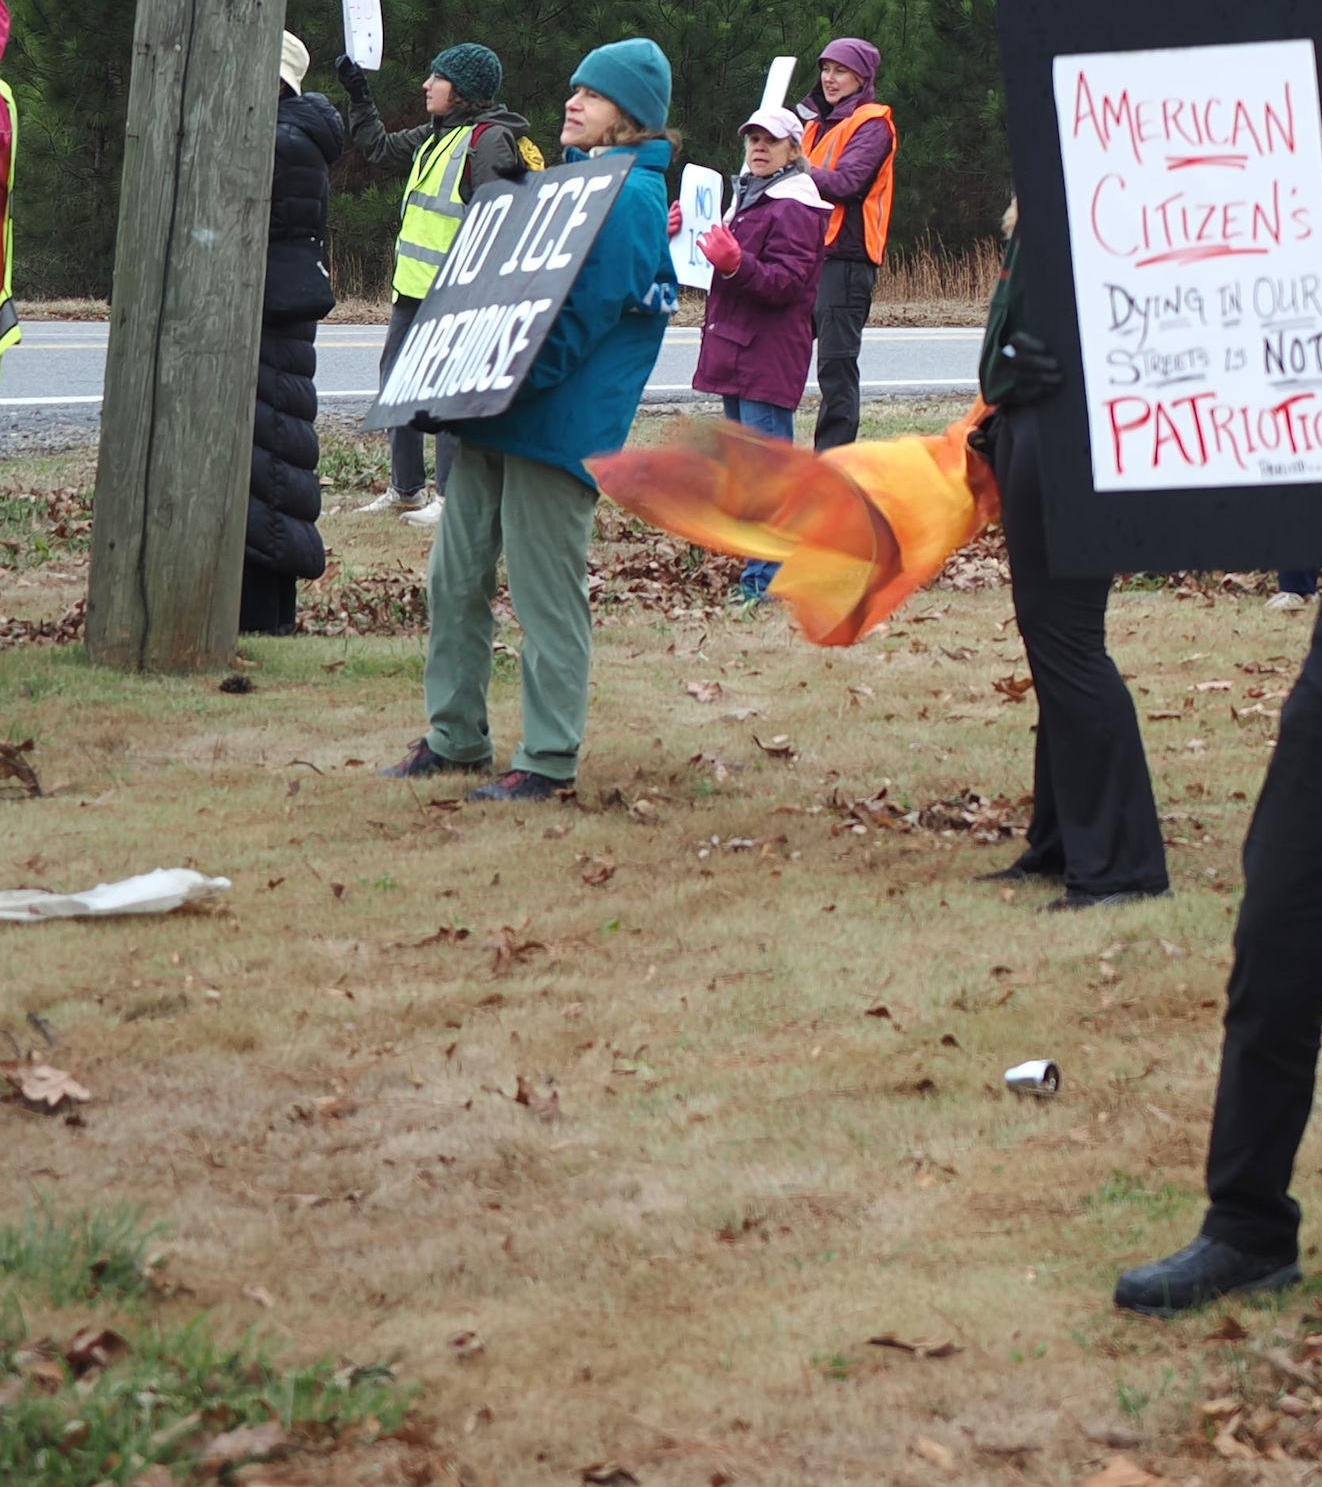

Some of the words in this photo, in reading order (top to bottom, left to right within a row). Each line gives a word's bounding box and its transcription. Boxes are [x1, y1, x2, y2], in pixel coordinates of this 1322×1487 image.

[1073, 70, 1296, 164] AMERICAN
[435, 194, 514, 290] NO
[499, 175, 613, 276] ICE
[695, 184, 713, 221] NO
[1217, 280, 1242, 317] IN
[379, 299, 552, 406] WAREHOUSE
